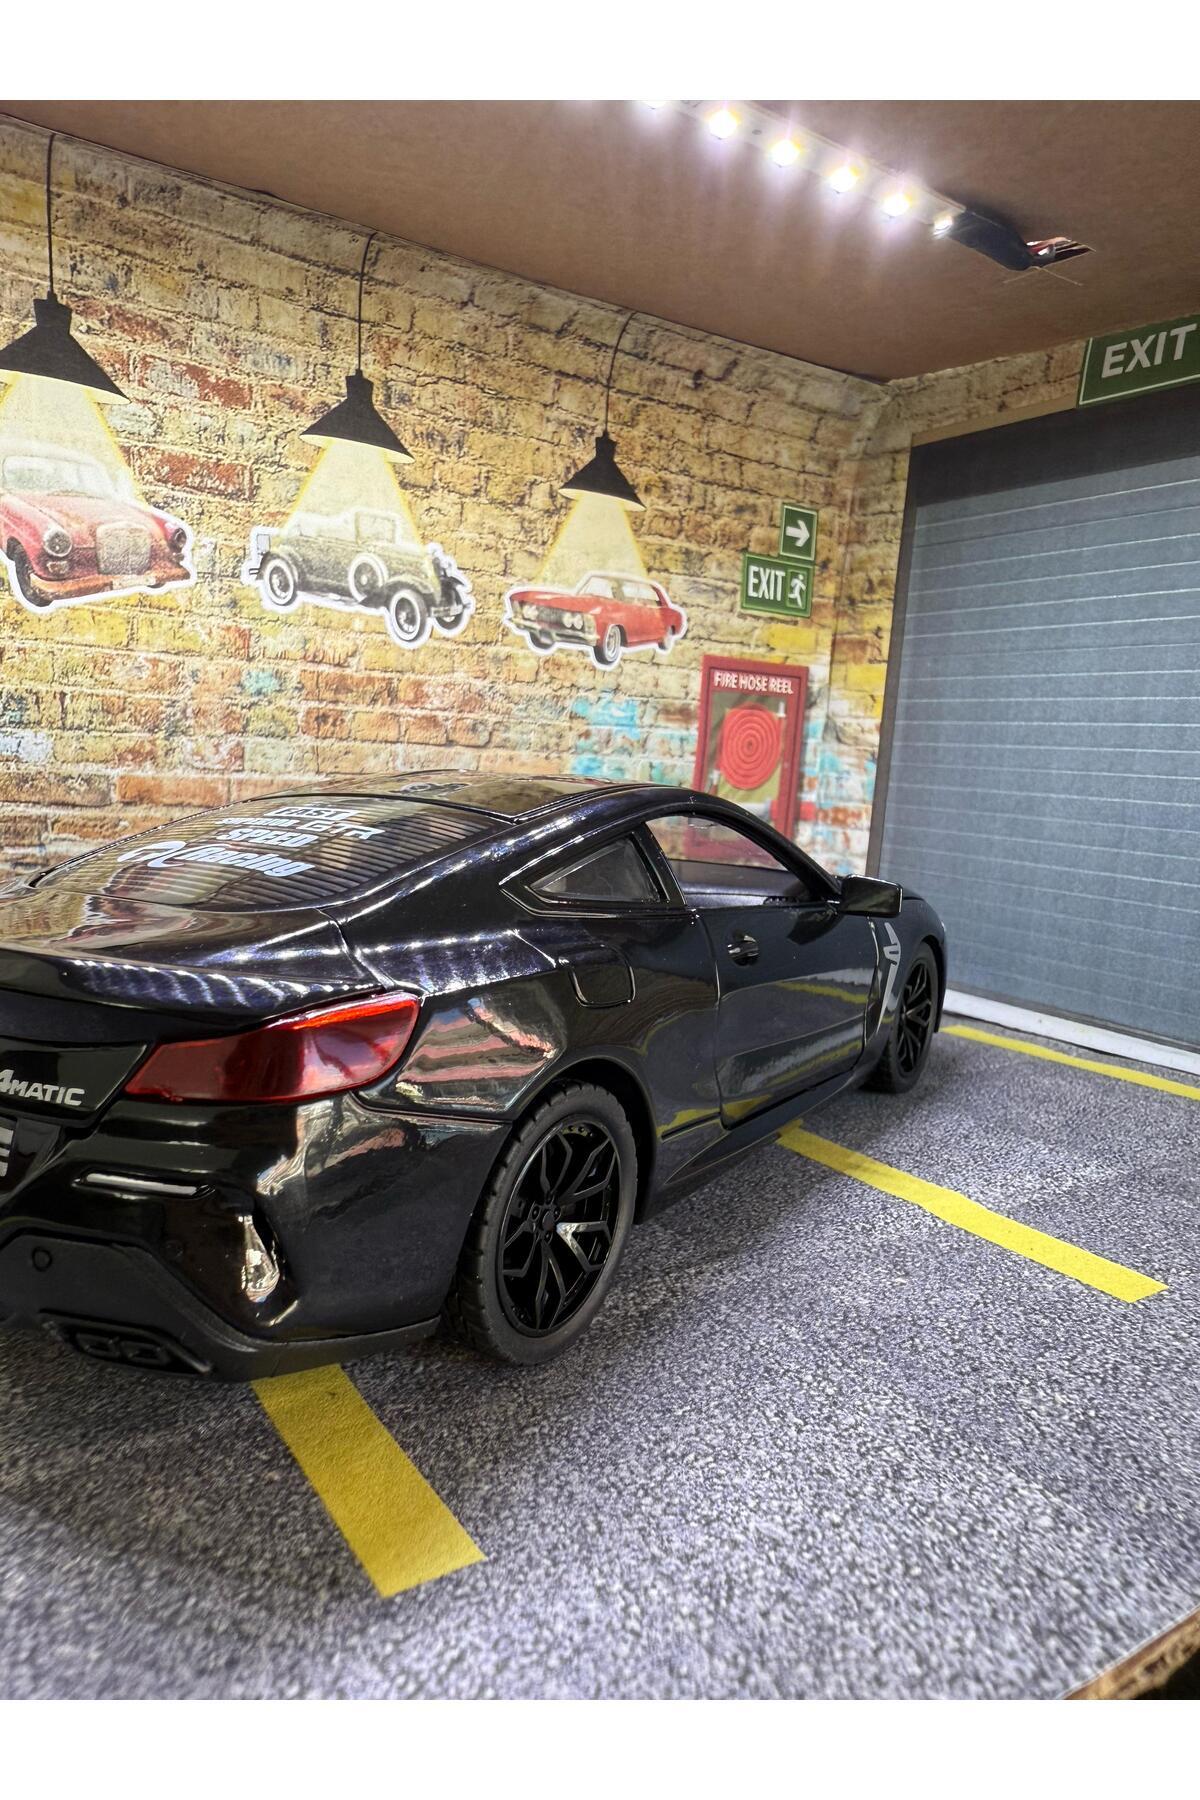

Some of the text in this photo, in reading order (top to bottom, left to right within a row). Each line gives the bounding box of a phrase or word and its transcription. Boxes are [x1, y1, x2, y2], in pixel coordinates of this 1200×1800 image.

[1101, 323, 1198, 379] EXIT
[747, 565, 786, 602] EXIT
[713, 670, 794, 695] FIRE HOSE REEL
[272, 806, 353, 819] FAST
[216, 828, 320, 848] SPEED
[296, 819, 386, 840] GTR
[0, 1069, 85, 1106] 4MATIC
